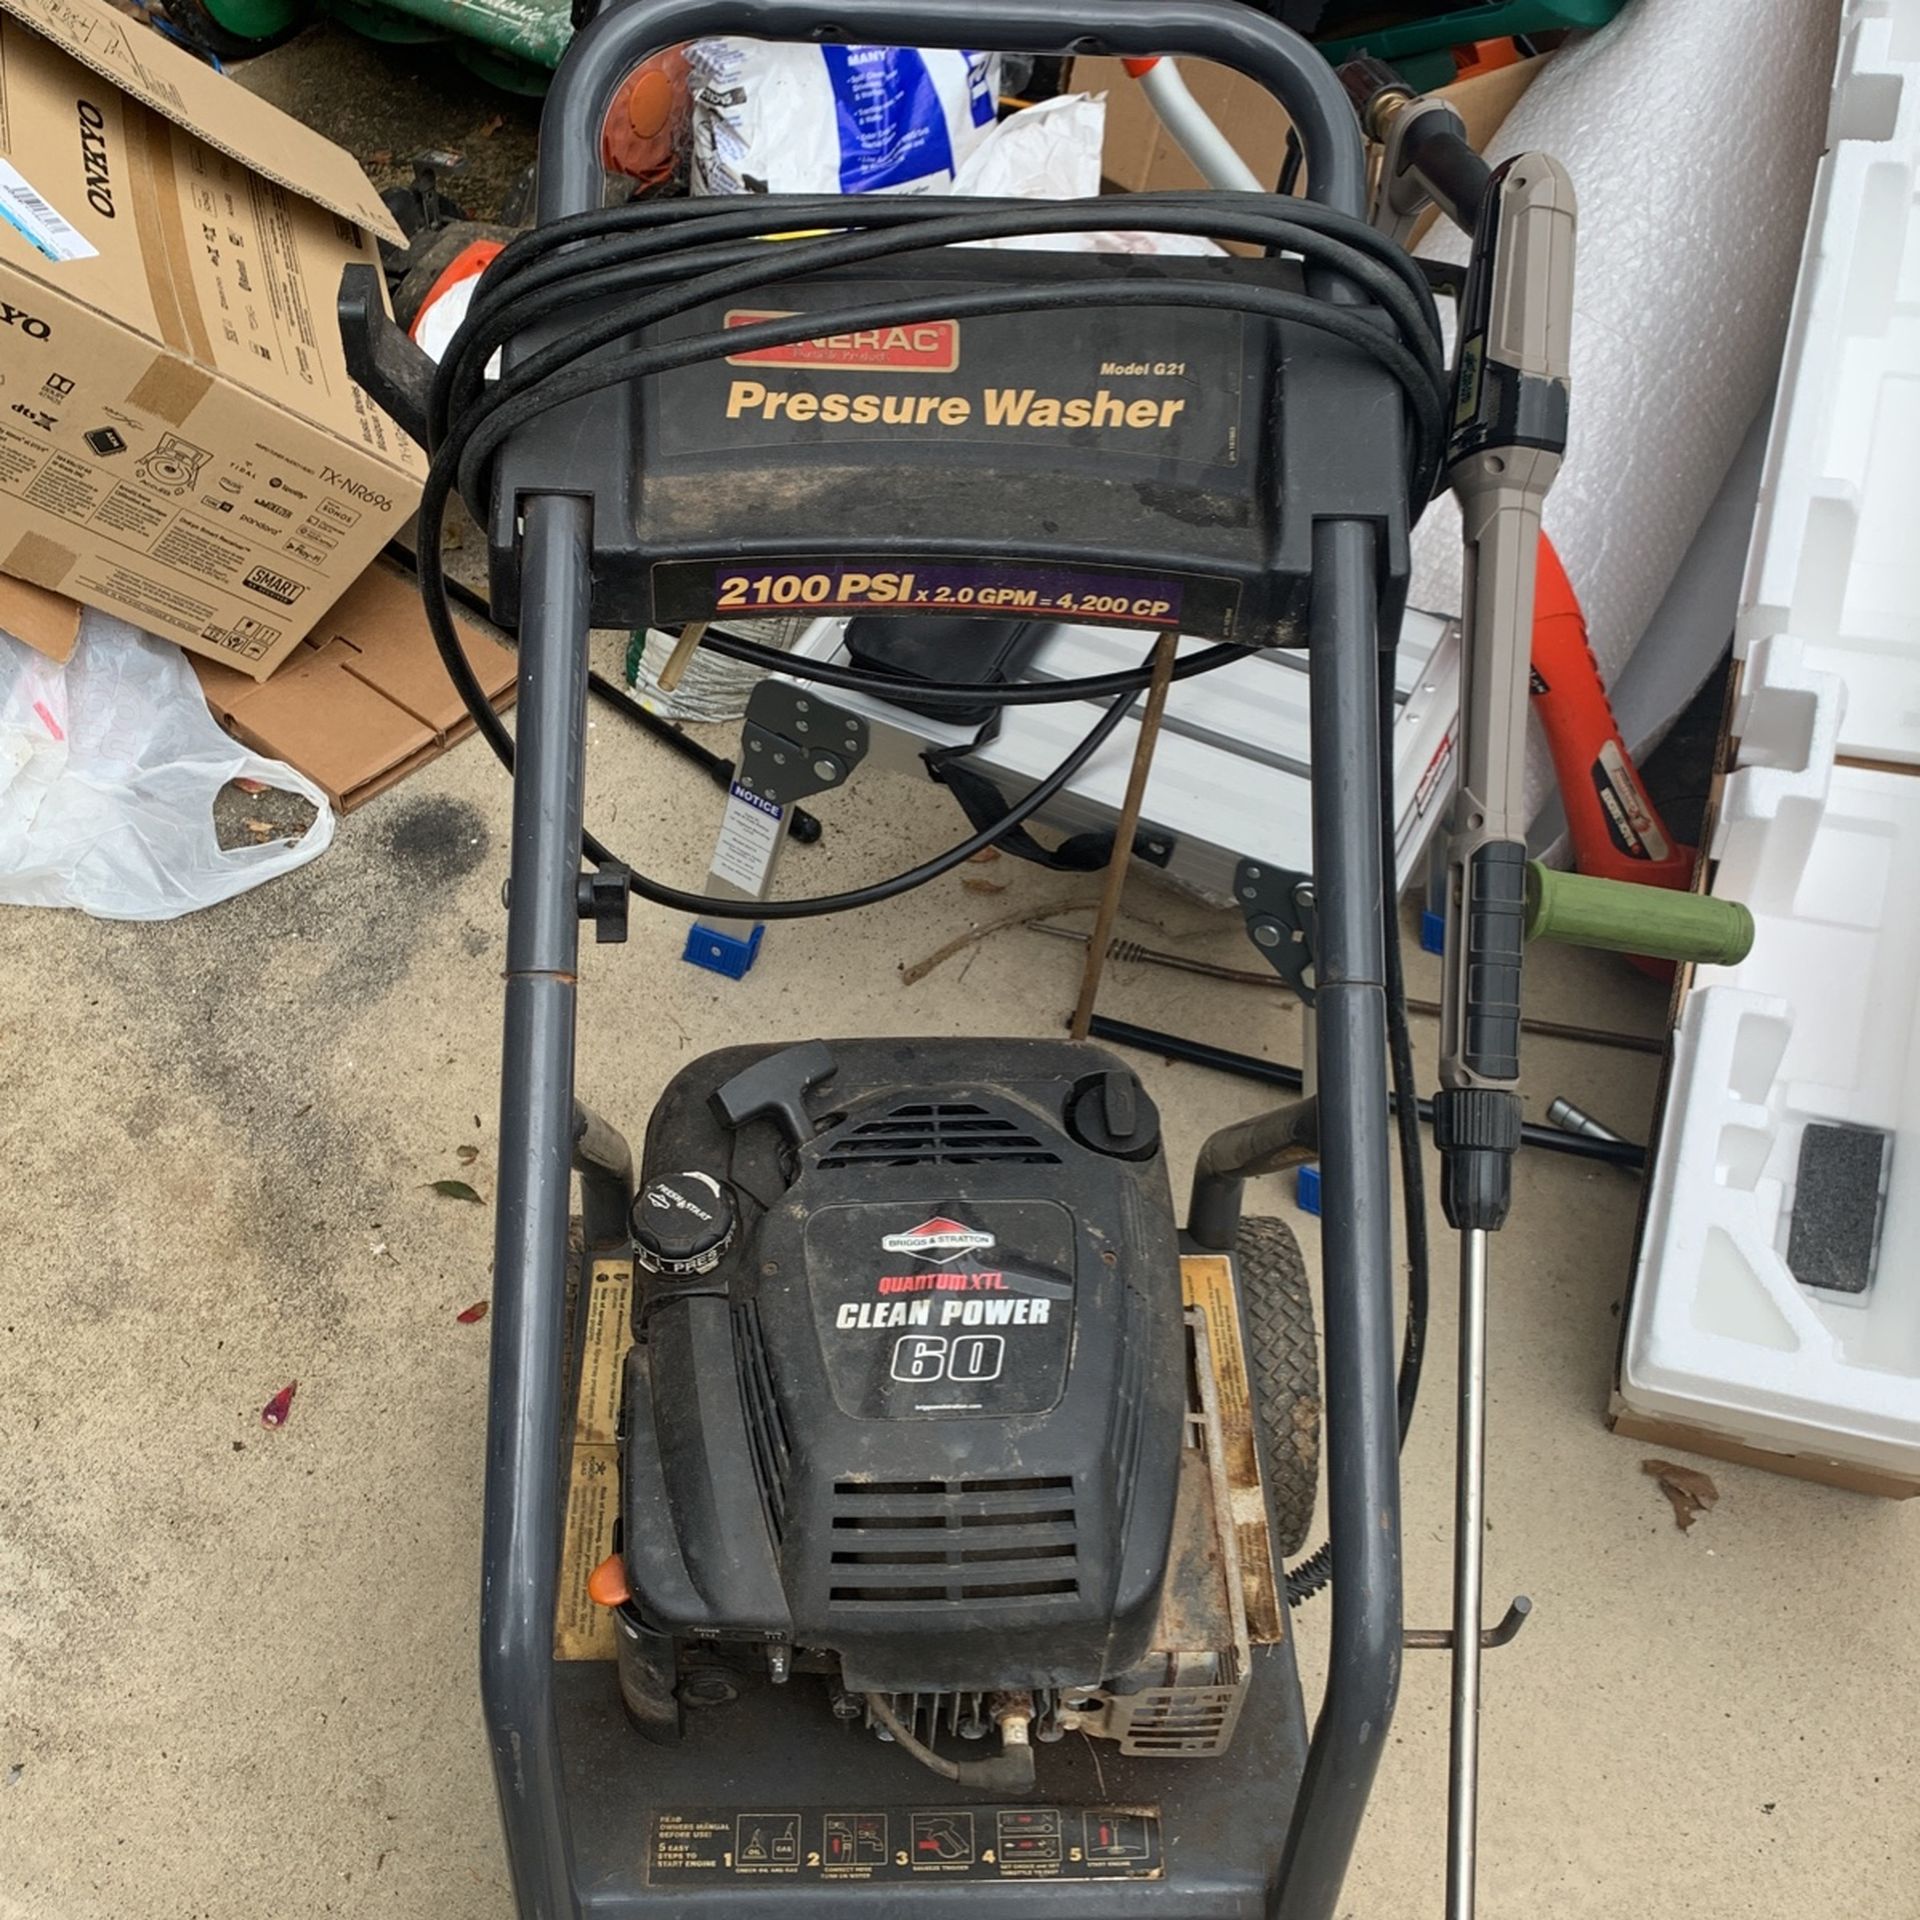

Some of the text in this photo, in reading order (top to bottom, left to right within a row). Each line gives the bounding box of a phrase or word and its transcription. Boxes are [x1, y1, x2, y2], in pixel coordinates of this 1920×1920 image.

[847, 50, 886, 66] MANY
[76, 99, 116, 219] ONKYO
[1101, 363, 1186, 375] Model G21
[726, 381, 1185, 429] Pressure Washer
[230, 462, 257, 480] TIDAL
[319, 466, 393, 513] TX-NR696
[323, 505, 353, 523] SONOS
[253, 567, 299, 600] SMART
[717, 575, 834, 607] 2100
[837, 573, 917, 603] PSI
[916, 591, 928, 602] x
[930, 587, 974, 603] 2.0
[978, 589, 1037, 608] GPM
[1056, 594, 1128, 615] 4,200
[1131, 599, 1170, 618] CP
[735, 785, 780, 817] NOTICE
[656, 1184, 713, 1221] FRESH START
[888, 1238, 928, 1248] BRIGGS
[938, 1235, 989, 1244] STRATTON
[835, 1299, 1051, 1329] CLEAN POWER
[890, 1334, 1005, 1383] 60
[695, 1823, 730, 1831] MANUAL
[658, 1842, 690, 1852] 5 EASY
[1069, 1847, 1082, 1861] 5
[657, 1860, 717, 1868] START ENGINE
[658, 1852, 698, 1860] STEPS TO
[723, 1852, 732, 1868] 1
[806, 1851, 820, 1867] 2
[895, 1851, 909, 1865] 3
[981, 1849, 996, 1864] 4
